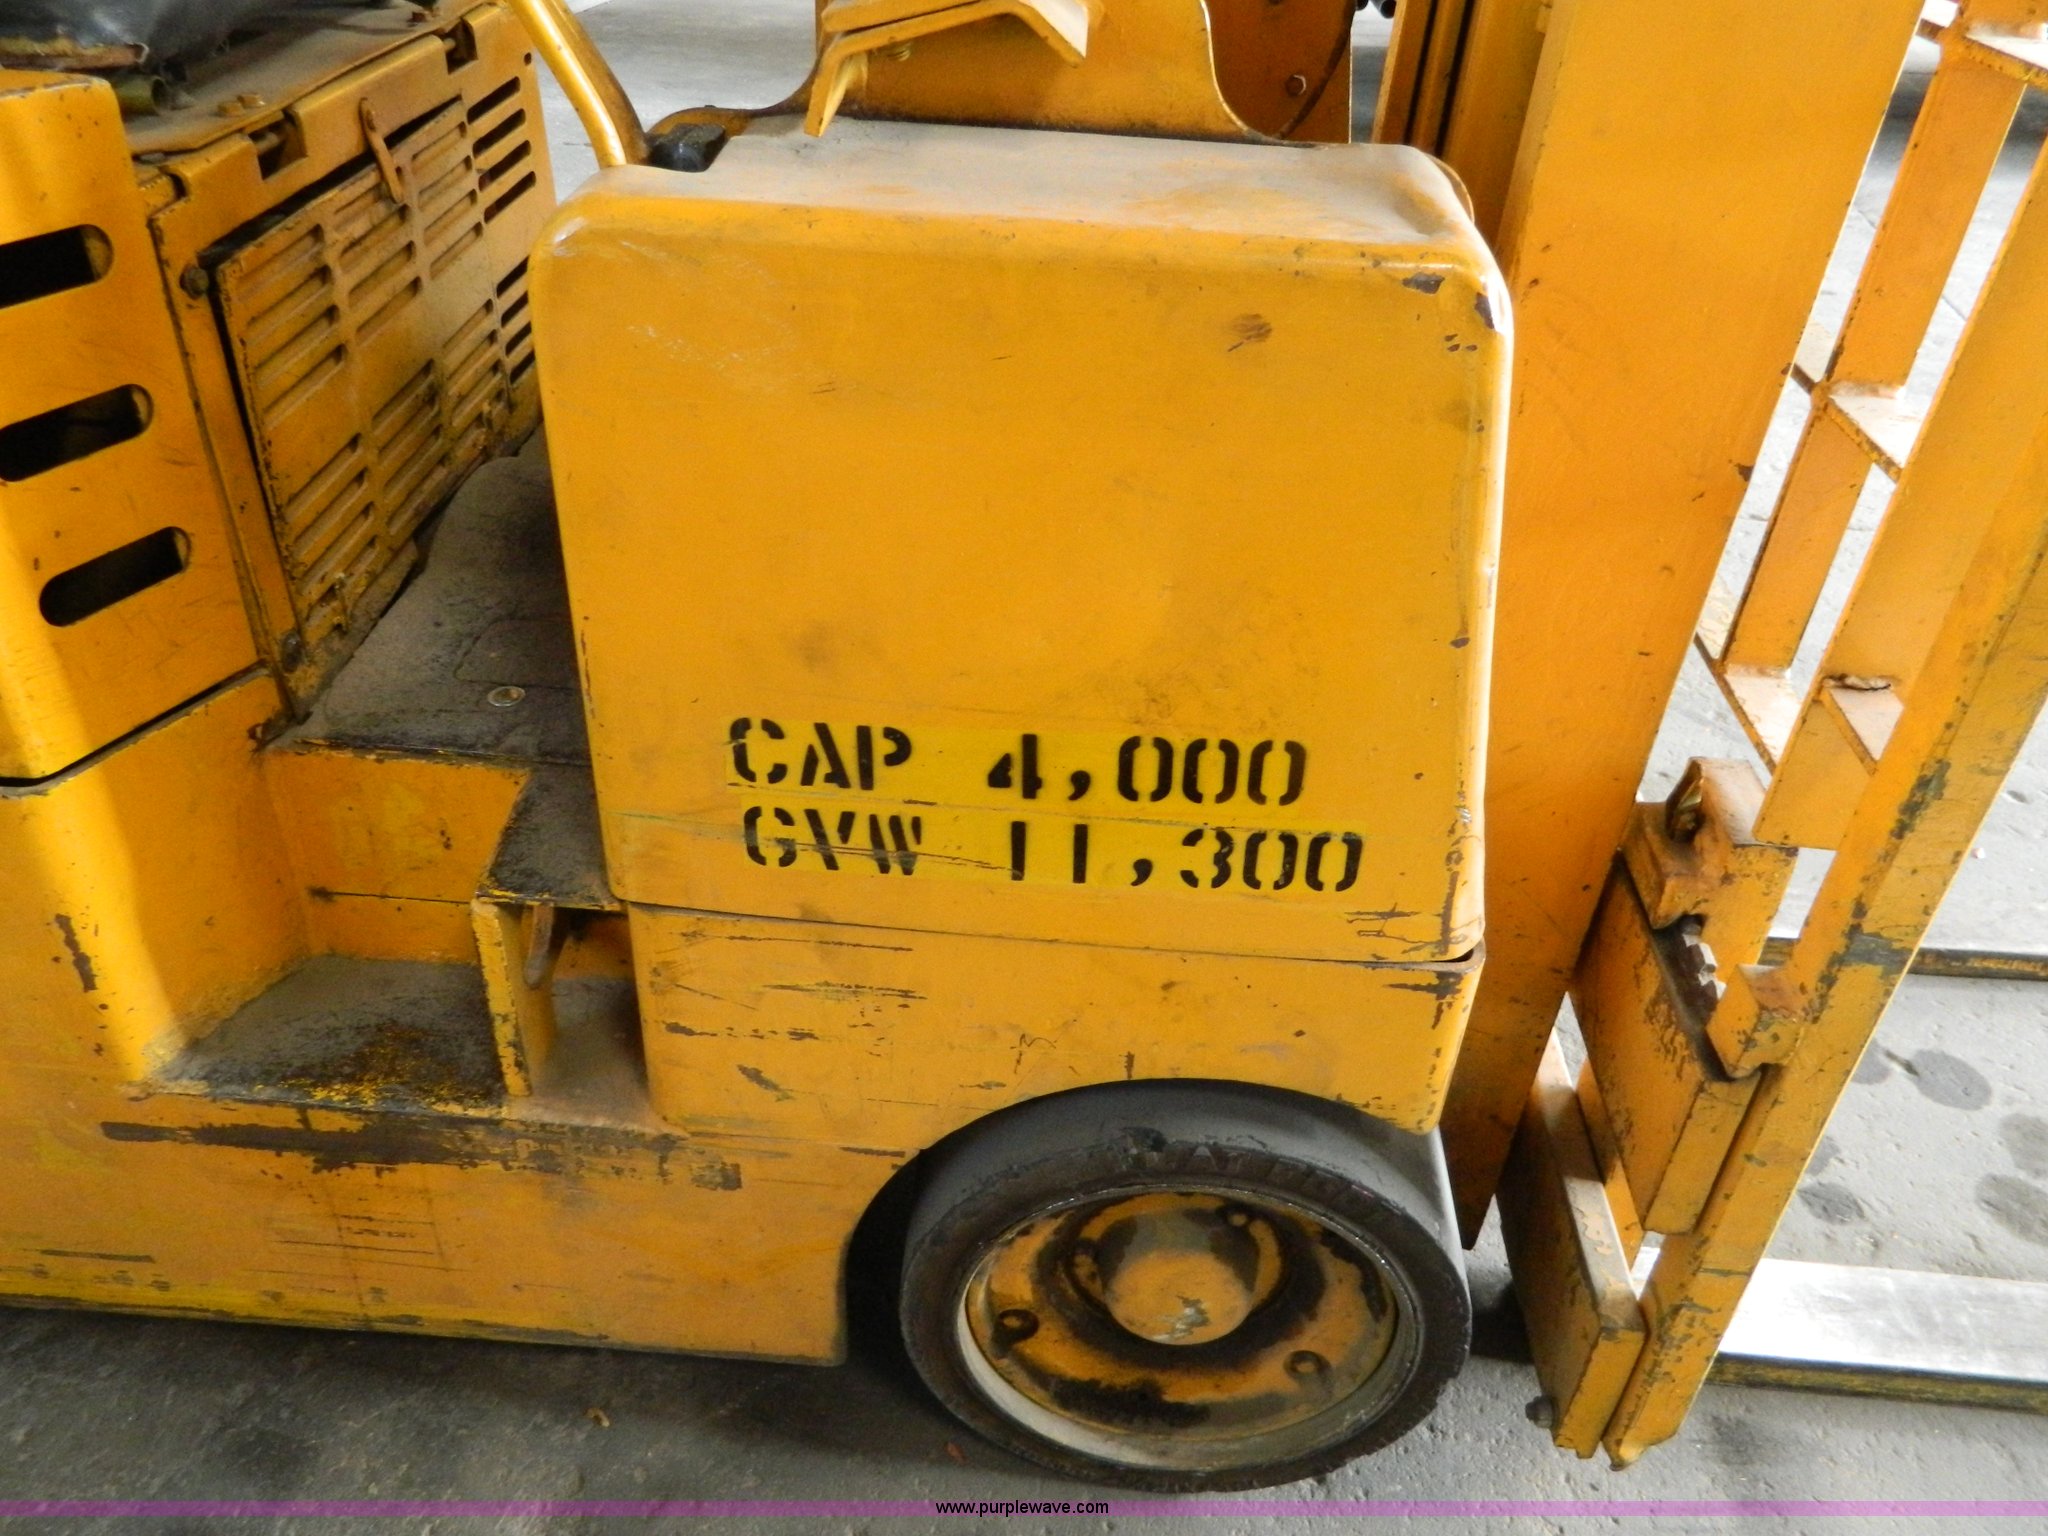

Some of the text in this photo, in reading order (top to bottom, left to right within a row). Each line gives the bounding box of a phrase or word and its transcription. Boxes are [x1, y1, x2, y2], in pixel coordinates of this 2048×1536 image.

[729, 717, 1306, 806] CAP 4,000
[743, 806, 1363, 892] GVW 11,300
